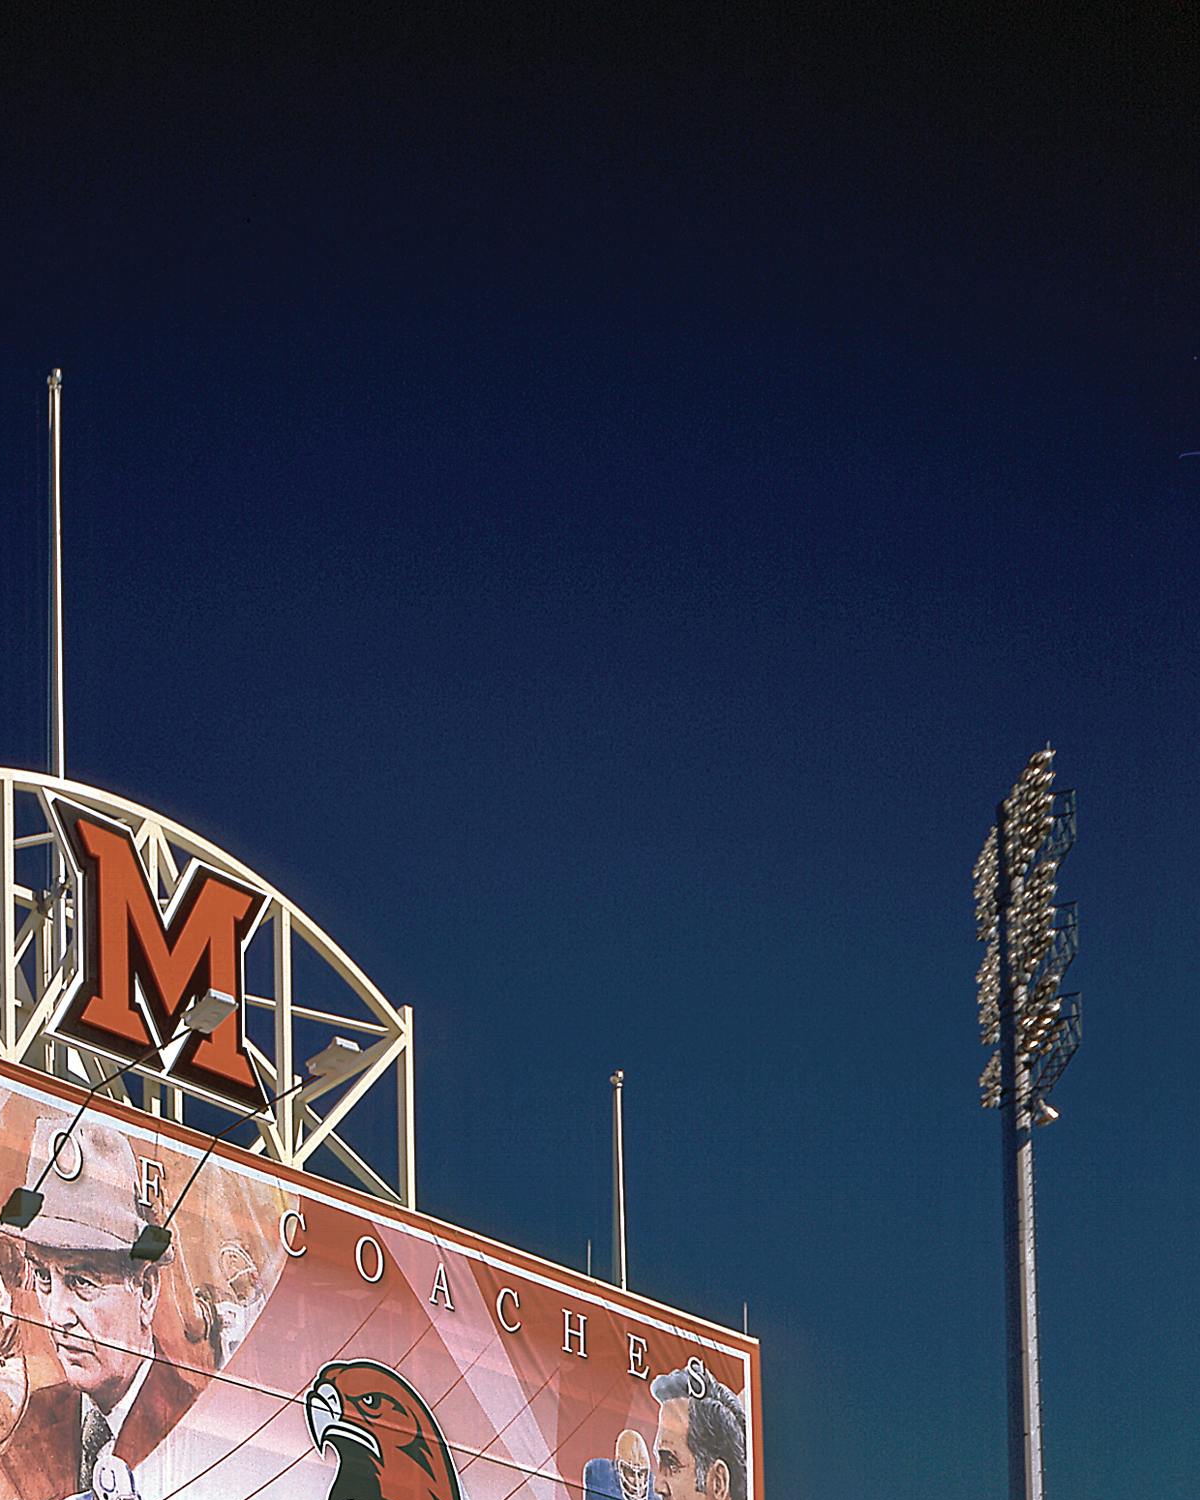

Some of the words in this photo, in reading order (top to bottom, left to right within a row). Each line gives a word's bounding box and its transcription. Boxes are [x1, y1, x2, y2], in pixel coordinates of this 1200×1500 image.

[62, 803, 268, 1112] M
[48, 1130, 167, 1208] OF
[279, 1209, 707, 1400] COACHES
